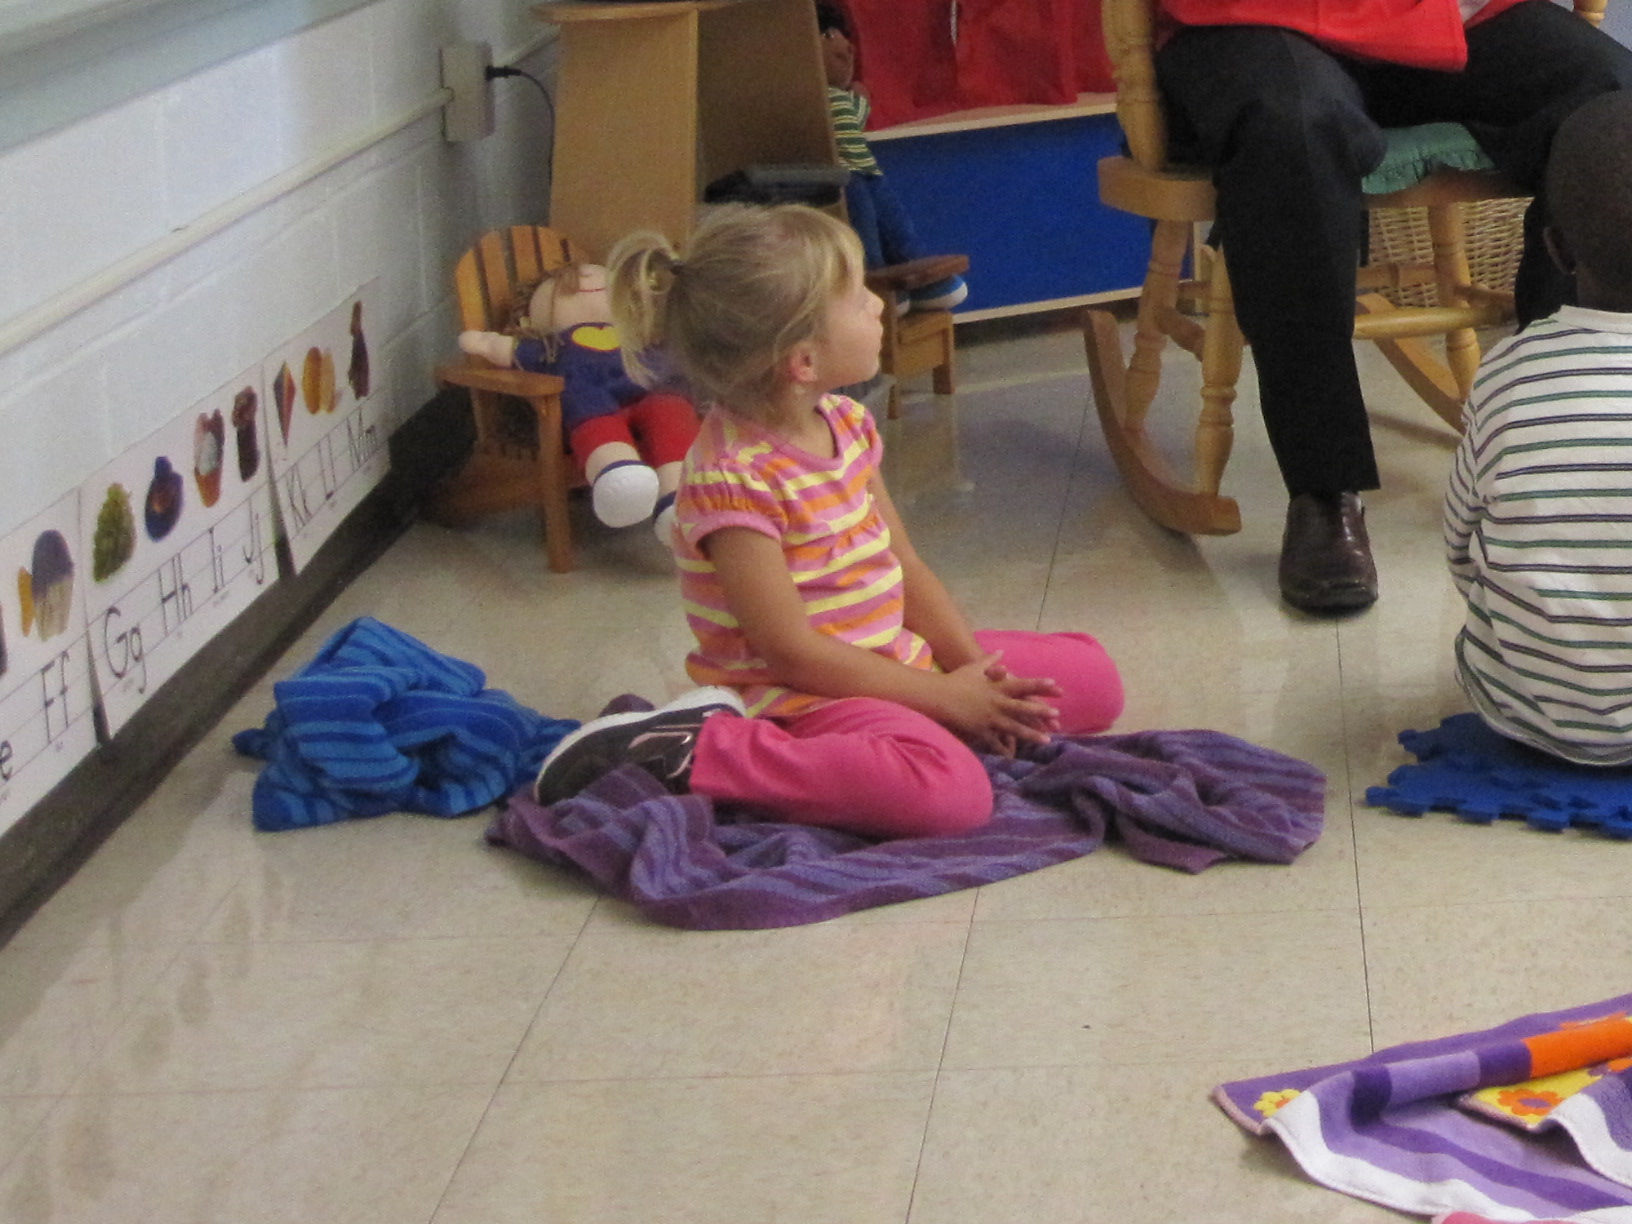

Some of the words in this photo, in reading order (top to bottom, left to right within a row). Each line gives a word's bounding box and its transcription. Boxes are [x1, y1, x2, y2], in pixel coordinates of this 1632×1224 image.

[158, 552, 193, 638] Hh
[104, 606, 147, 694] Gg
[41, 650, 70, 744] Ff
